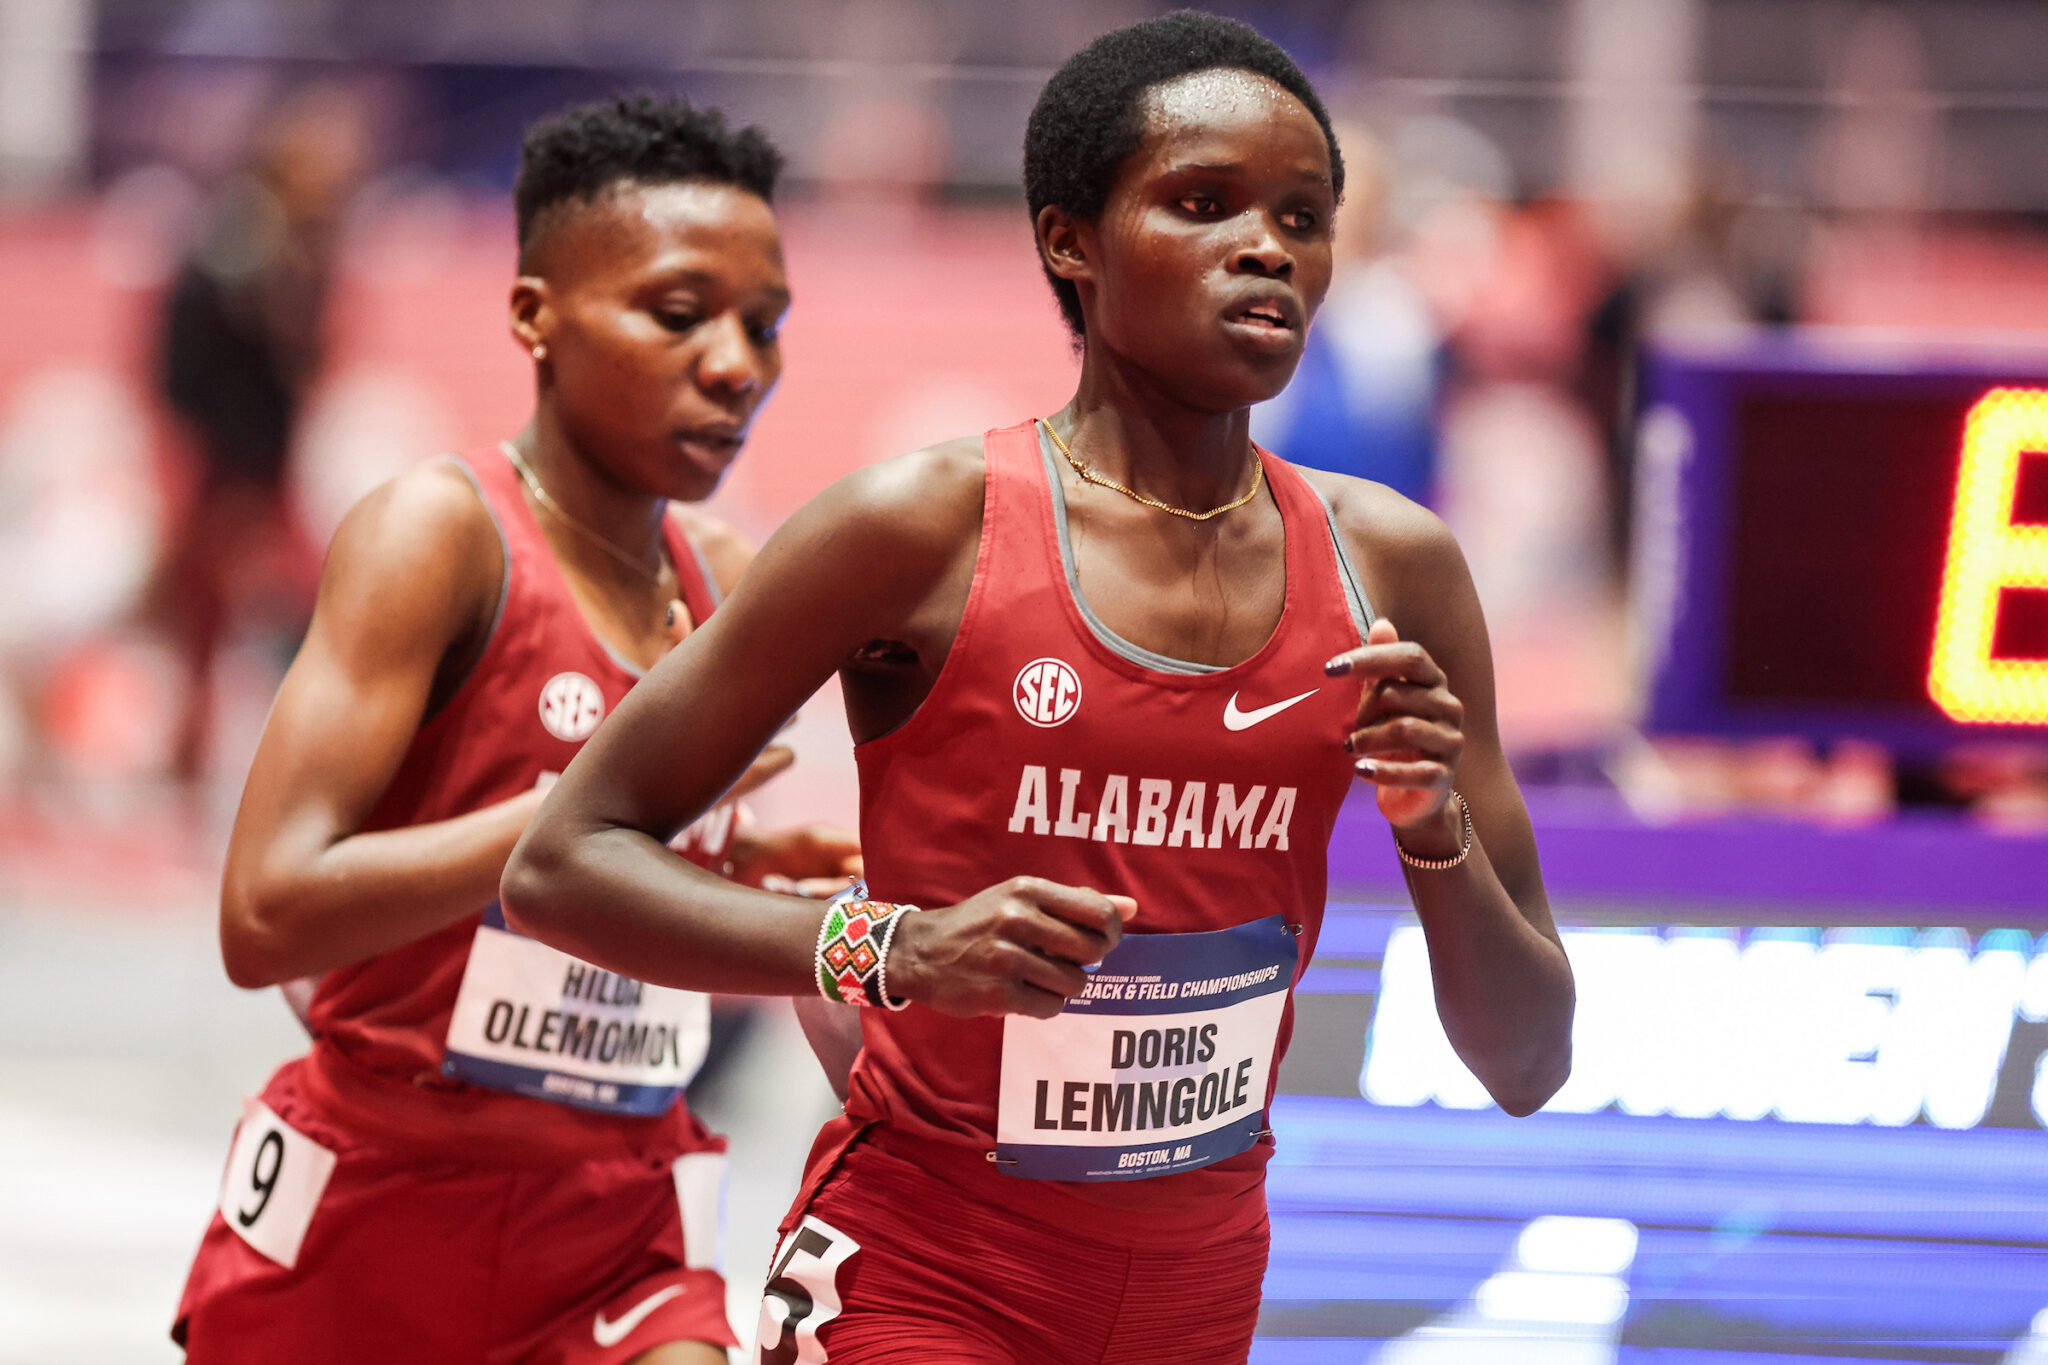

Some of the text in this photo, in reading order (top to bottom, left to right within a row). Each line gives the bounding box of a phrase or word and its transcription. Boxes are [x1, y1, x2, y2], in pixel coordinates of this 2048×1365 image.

[1018, 660, 1079, 724] SEC
[1007, 764, 1298, 852] ALABAMA
[1080, 964, 1280, 1000] RACK & FIELD CHAMPIONSHIPS
[1095, 974, 1129, 983] DIVISION
[1135, 975, 1162, 984] INDOOR
[1111, 1023, 1218, 1070] DORIS
[1034, 1057, 1254, 1133] LEMNGOLE
[236, 1128, 286, 1229] 9
[1118, 1148, 1171, 1169] BOSTON,
[1173, 1144, 1192, 1162] MA
[760, 1226, 834, 1365] 5
